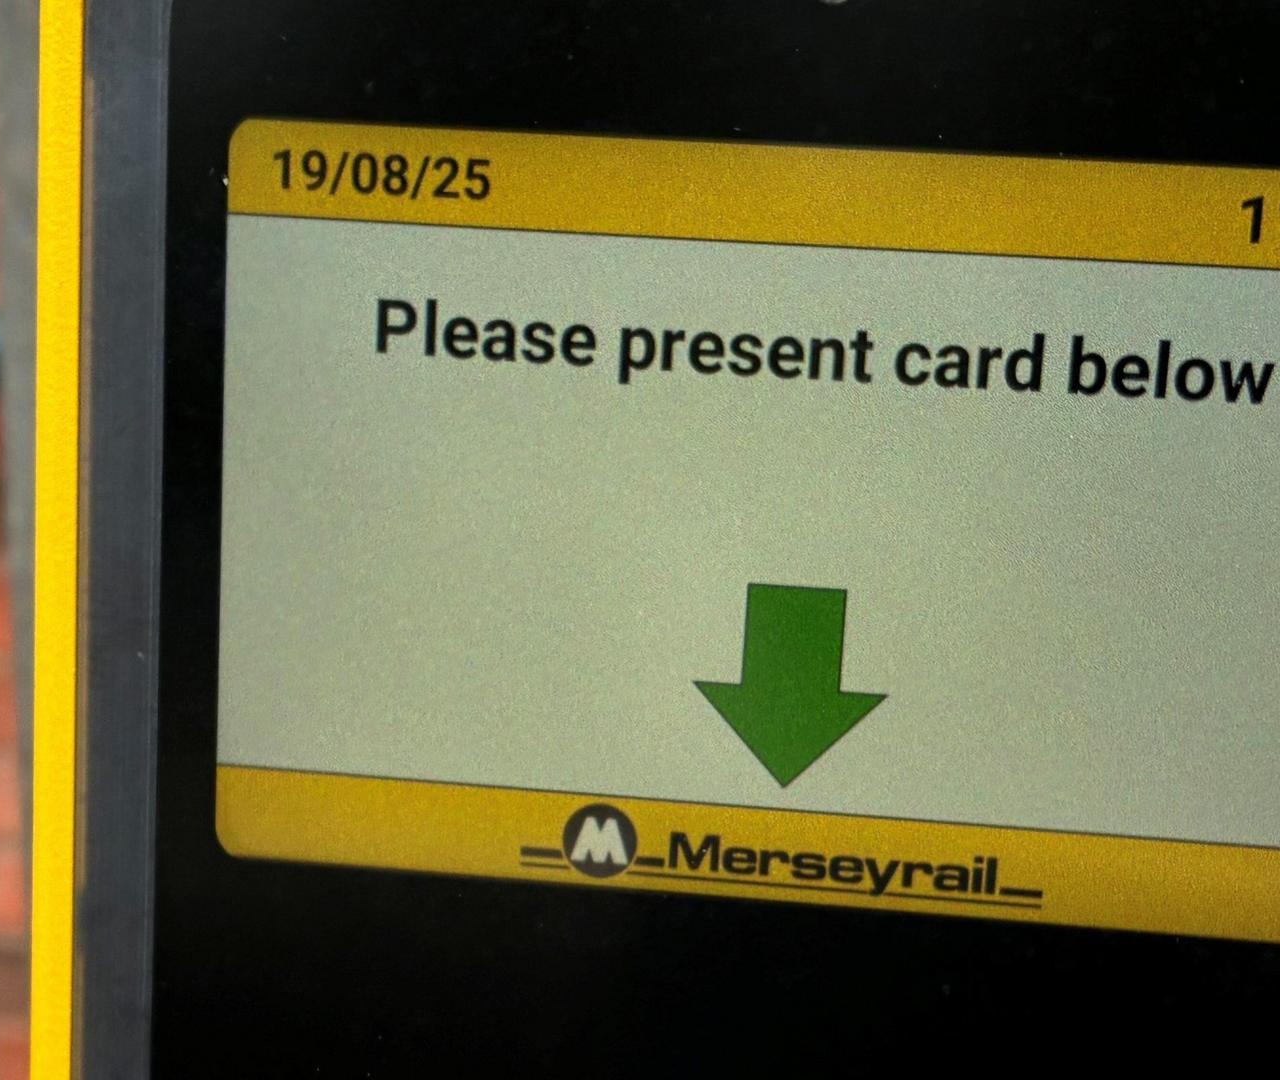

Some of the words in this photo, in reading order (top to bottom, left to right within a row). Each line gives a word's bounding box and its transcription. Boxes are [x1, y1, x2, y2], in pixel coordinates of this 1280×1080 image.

[270, 147, 493, 202] 19/08/25
[374, 297, 597, 368] Please
[618, 325, 874, 386] present
[893, 333, 1047, 394] card
[1066, 335, 1275, 405] below
[668, 831, 998, 895] Merseyrail
